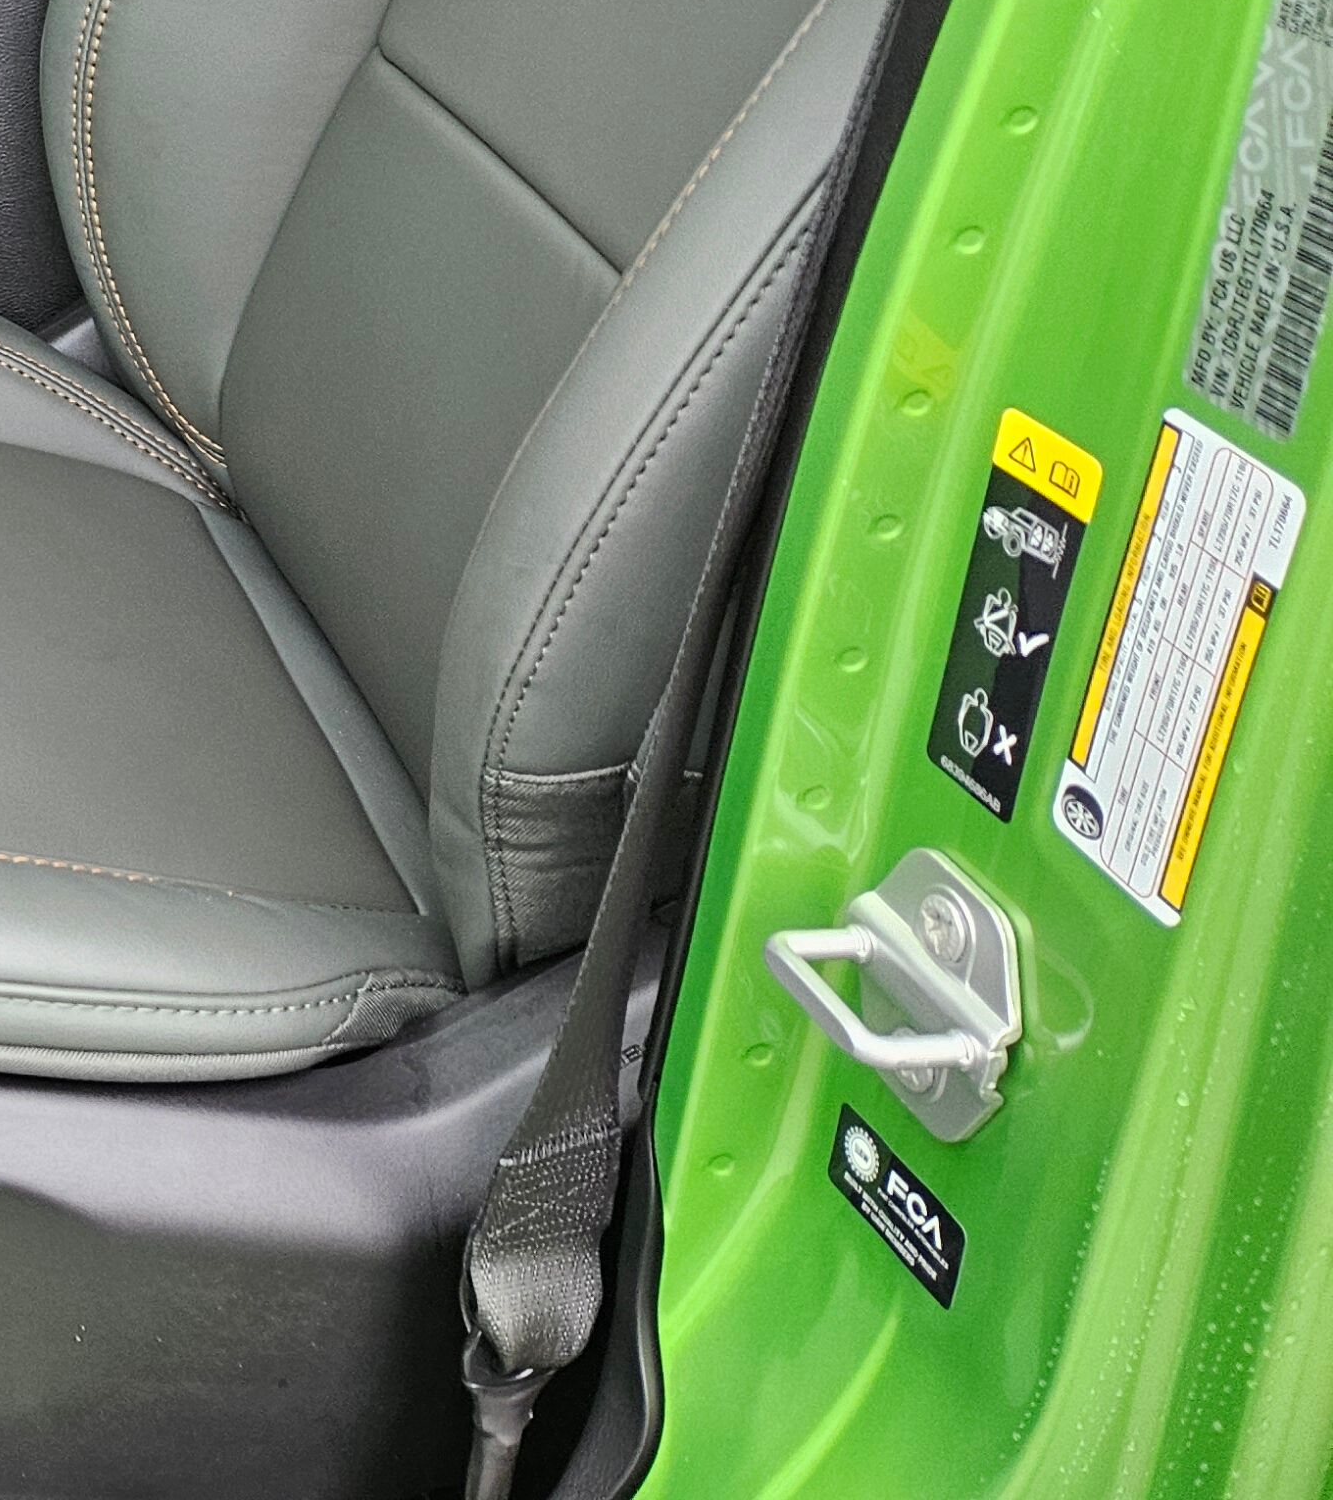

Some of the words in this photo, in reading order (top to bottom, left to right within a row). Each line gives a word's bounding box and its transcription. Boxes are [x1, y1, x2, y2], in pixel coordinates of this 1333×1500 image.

[1225, 210, 1246, 248] LLC
[1269, 194, 1297, 255] U.S.A.
[1218, 245, 1238, 276] US
[1261, 252, 1282, 285] IN:
[1209, 274, 1230, 312] FCA
[1248, 282, 1275, 338] MADE
[1201, 313, 1220, 346] BY:
[1190, 346, 1212, 389] MFD
[1209, 361, 1231, 401] VIN:
[1228, 336, 1261, 414] VEHICLE
[885, 1167, 944, 1251] FCA
